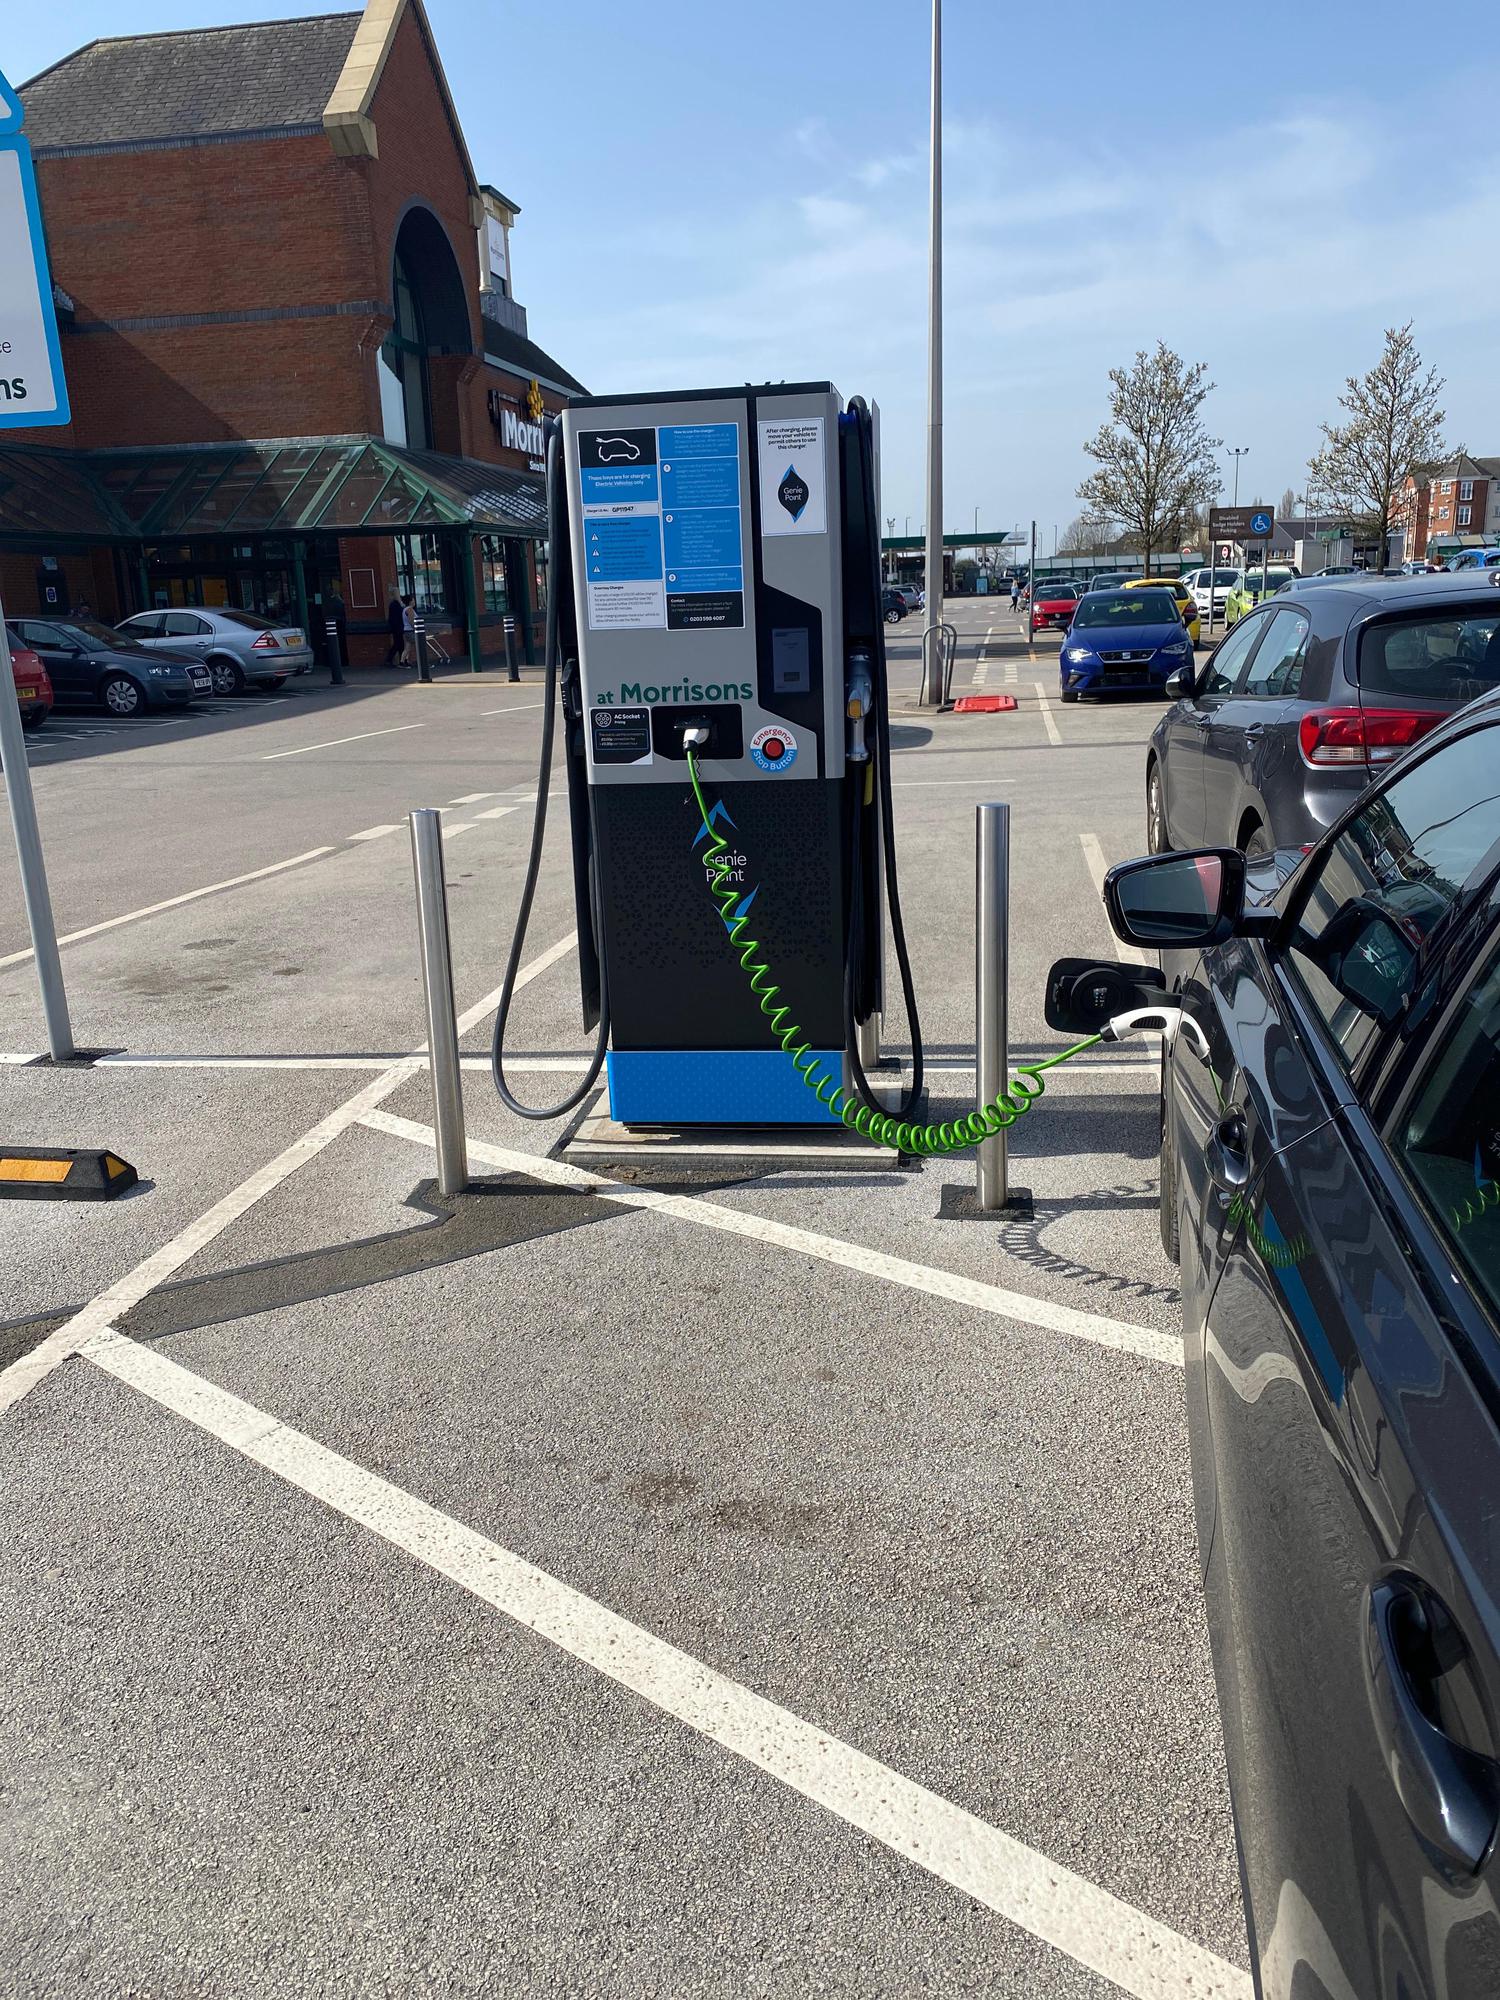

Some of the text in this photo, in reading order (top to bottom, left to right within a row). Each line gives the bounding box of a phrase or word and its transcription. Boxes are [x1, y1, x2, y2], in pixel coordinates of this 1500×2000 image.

[501, 409, 545, 456] Morri
[783, 485, 803, 494] Genie
[597, 677, 753, 704] at Morrisons
[753, 729, 793, 746] Emergency
[753, 750, 794, 770] Stop Button
